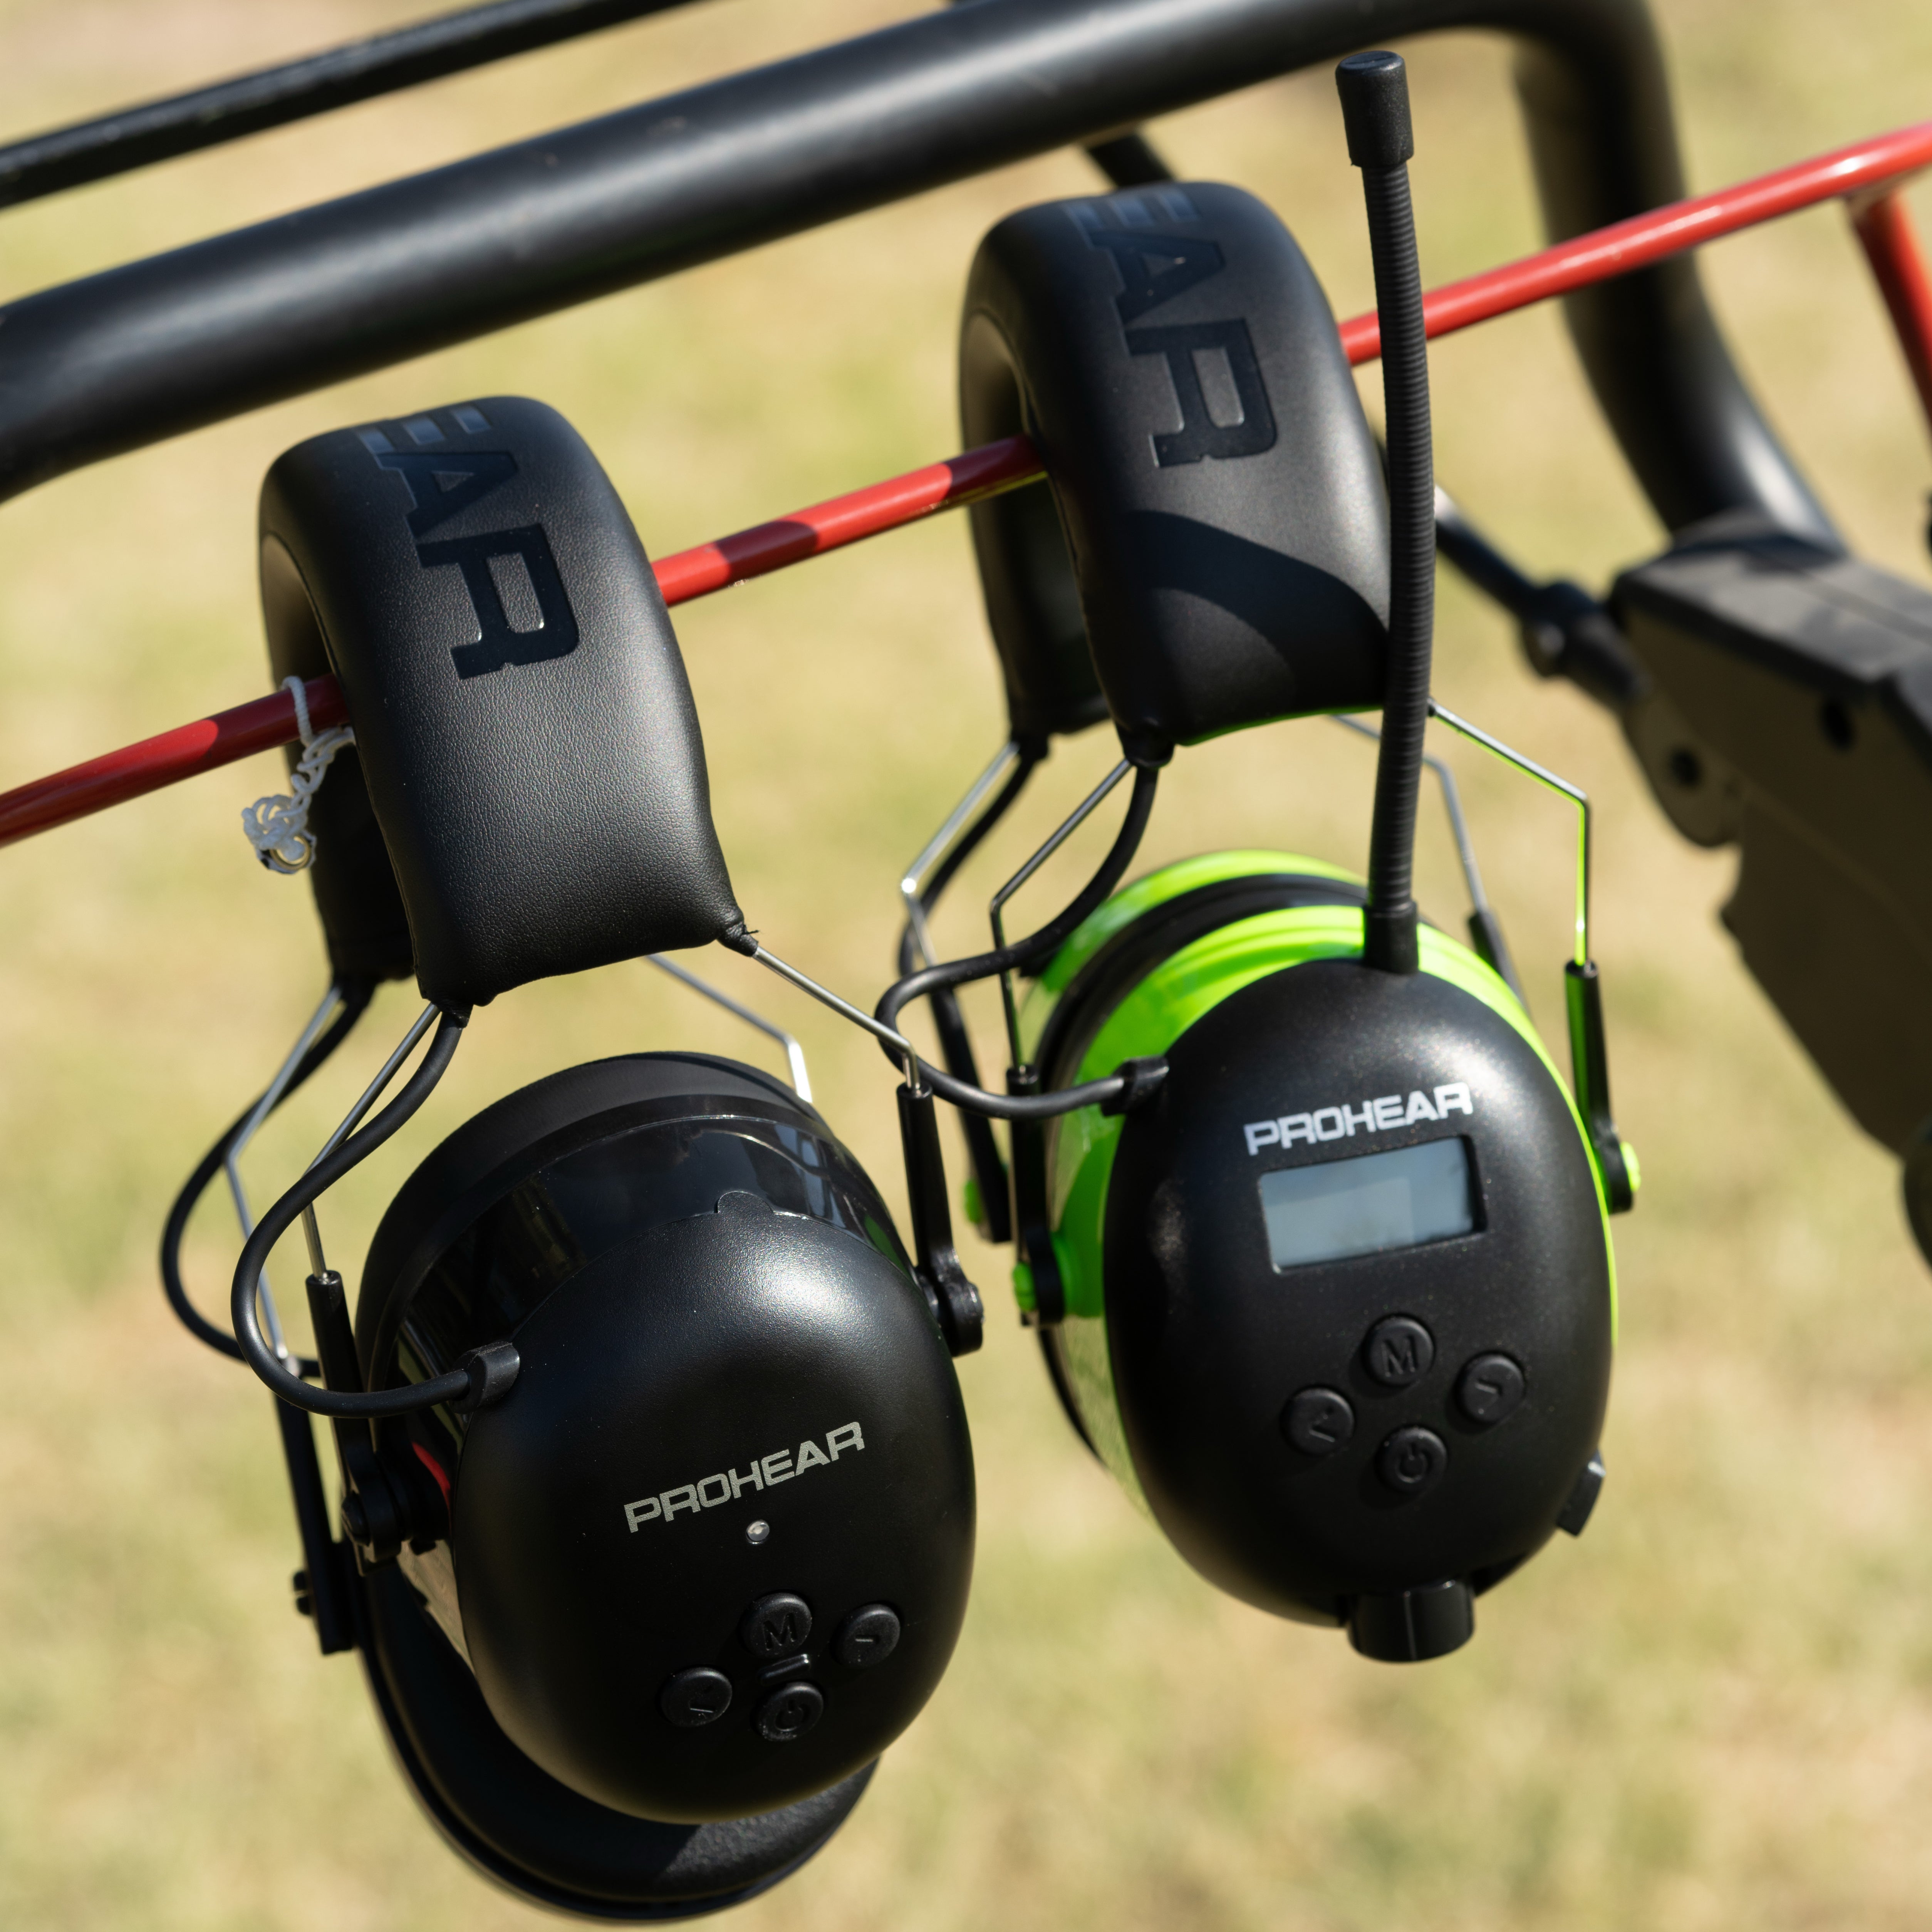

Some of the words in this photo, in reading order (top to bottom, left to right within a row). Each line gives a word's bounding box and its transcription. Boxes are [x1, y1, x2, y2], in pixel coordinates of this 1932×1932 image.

[1244, 1082, 1473, 1156] PROHEAR
[1381, 1333, 1420, 1377] M
[624, 1422, 865, 1533] PROHEAR
[761, 1612, 798, 1652] M
